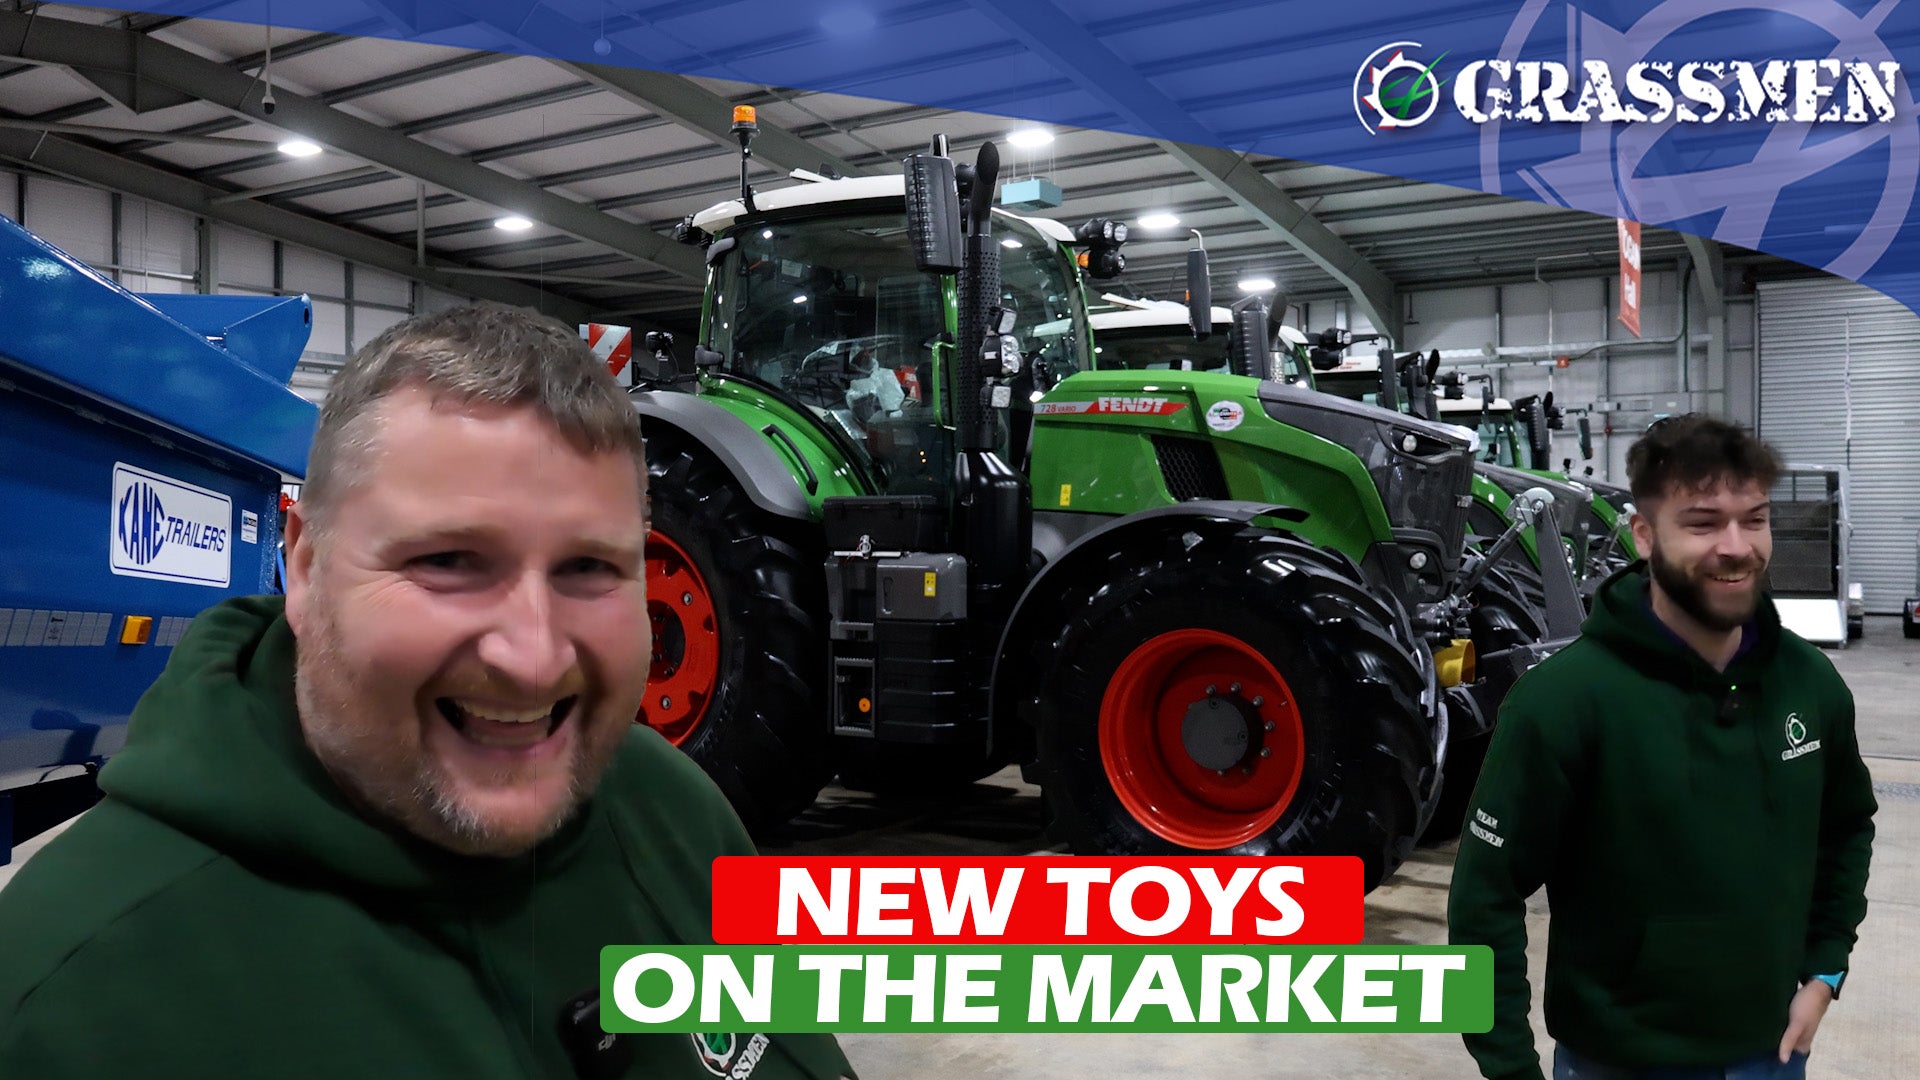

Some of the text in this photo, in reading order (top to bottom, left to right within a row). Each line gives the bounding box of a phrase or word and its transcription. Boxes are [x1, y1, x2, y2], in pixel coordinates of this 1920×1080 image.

[1041, 403, 1057, 413] 728
[1098, 397, 1169, 413] FENDT
[118, 481, 165, 565] KANE
[165, 516, 227, 553] TRAILERS
